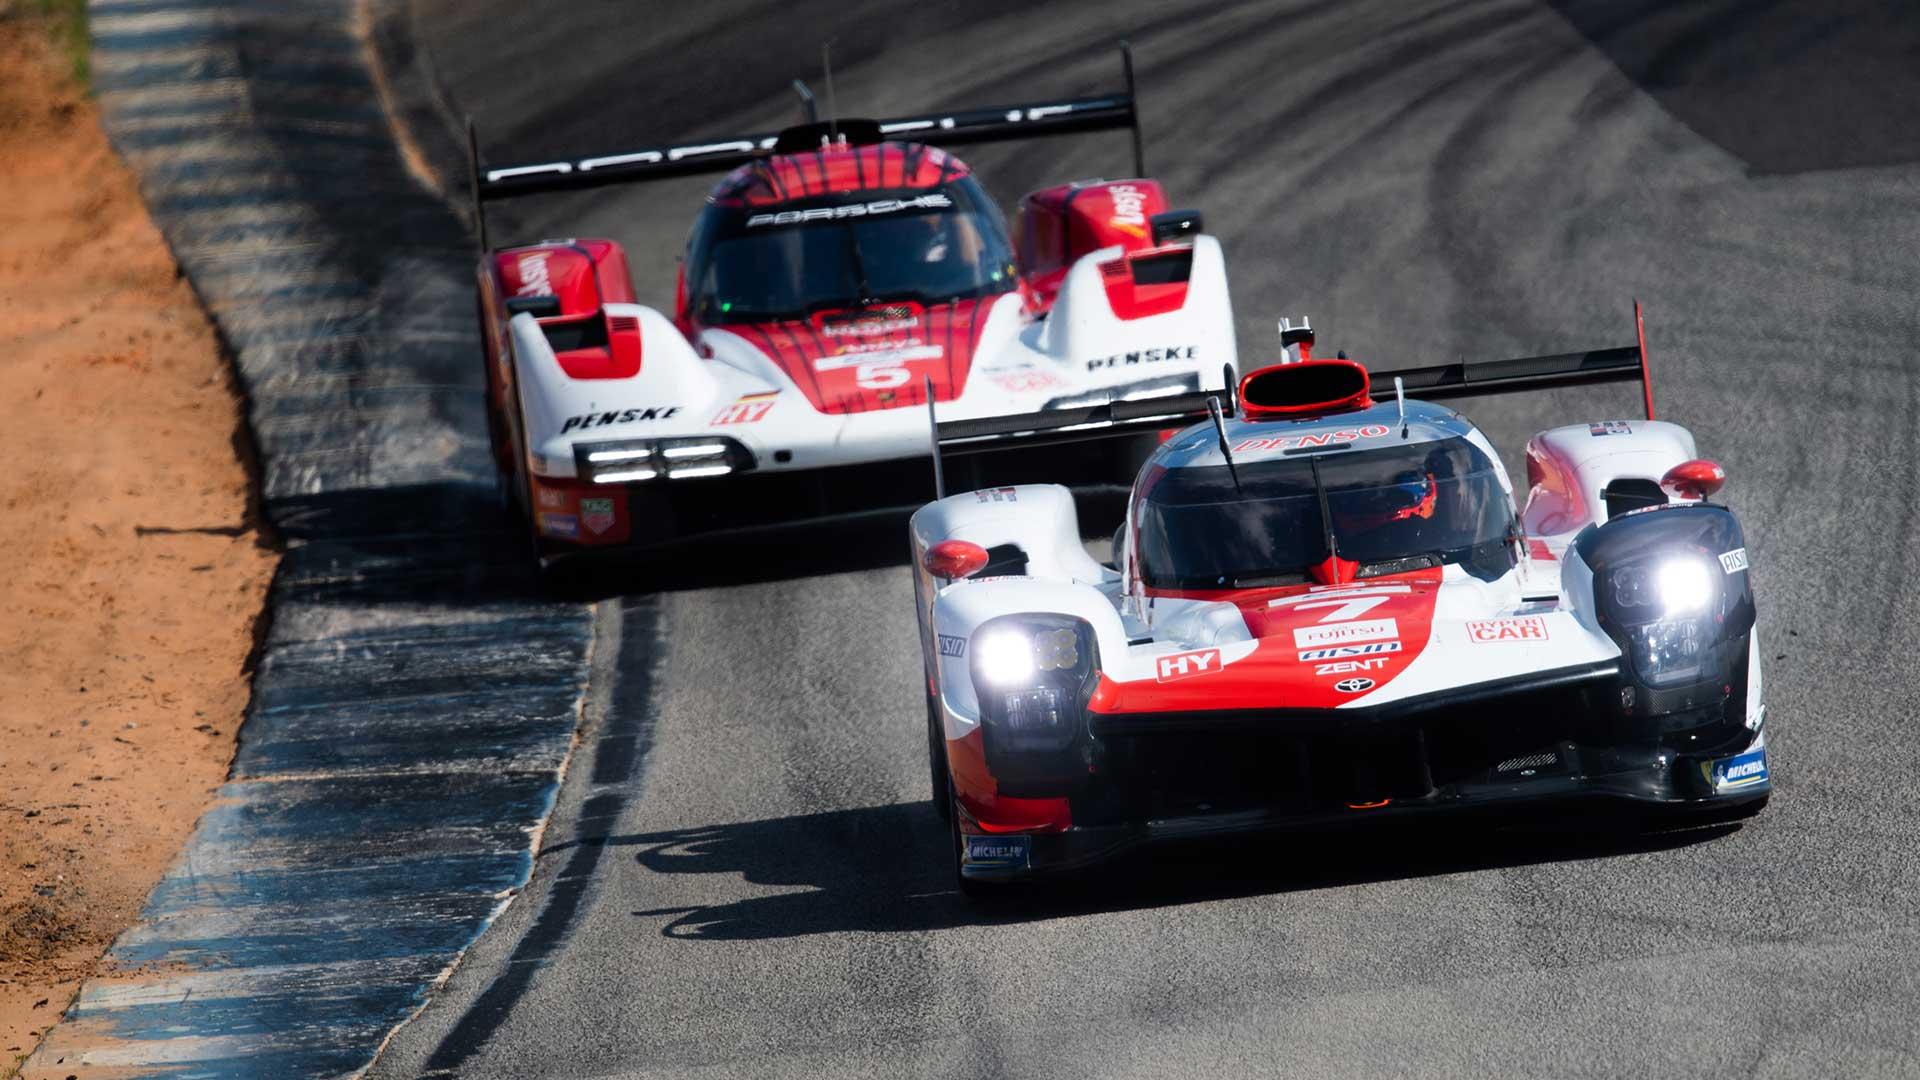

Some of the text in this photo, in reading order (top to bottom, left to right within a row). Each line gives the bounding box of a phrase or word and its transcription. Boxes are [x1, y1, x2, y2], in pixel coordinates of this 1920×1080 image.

[746, 194, 952, 228] PORSCHE
[1087, 346, 1199, 372] PENSKE
[856, 361, 911, 389] 5
[560, 405, 684, 435] PENSKE
[1232, 424, 1389, 452] DENSO
[1293, 596, 1390, 623] 7
[1307, 626, 1385, 640] FUJITSU
[1472, 619, 1537, 630] HYPER
[1475, 626, 1542, 640] CAR
[1160, 651, 1216, 677] HY
[1302, 643, 1398, 660] AISIN
[1314, 657, 1390, 676] ZENT
